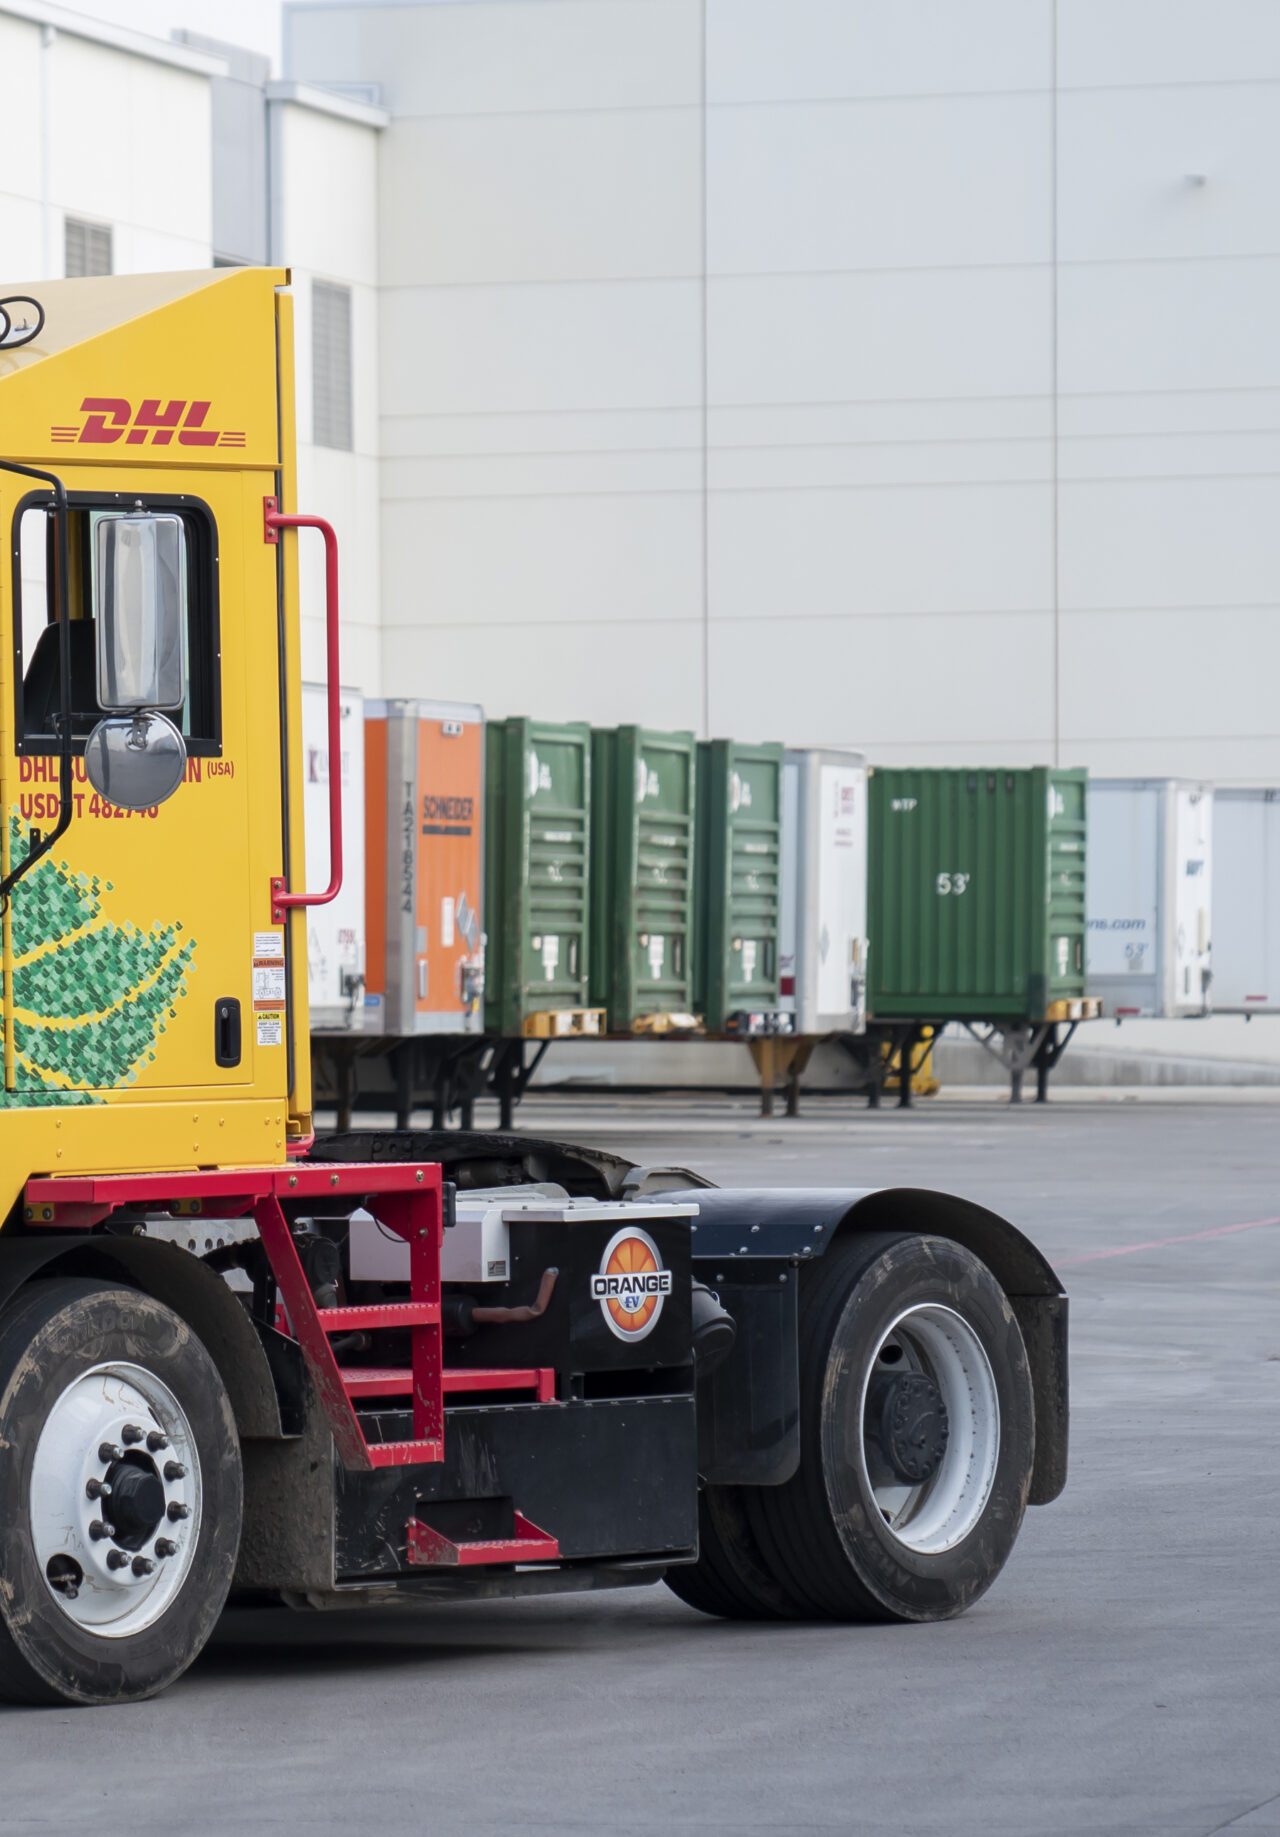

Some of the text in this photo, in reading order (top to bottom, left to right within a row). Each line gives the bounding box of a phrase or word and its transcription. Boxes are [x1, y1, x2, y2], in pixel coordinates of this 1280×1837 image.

[77, 397, 221, 447] DHL
[19, 756, 59, 783] DHL
[206, 760, 235, 780] (USA)
[20, 792, 86, 819] USDT
[423, 795, 473, 821] SCHNEIDER
[936, 872, 970, 895] 53'
[593, 1274, 670, 1296] ORANGE
[624, 1295, 640, 1309] EV
